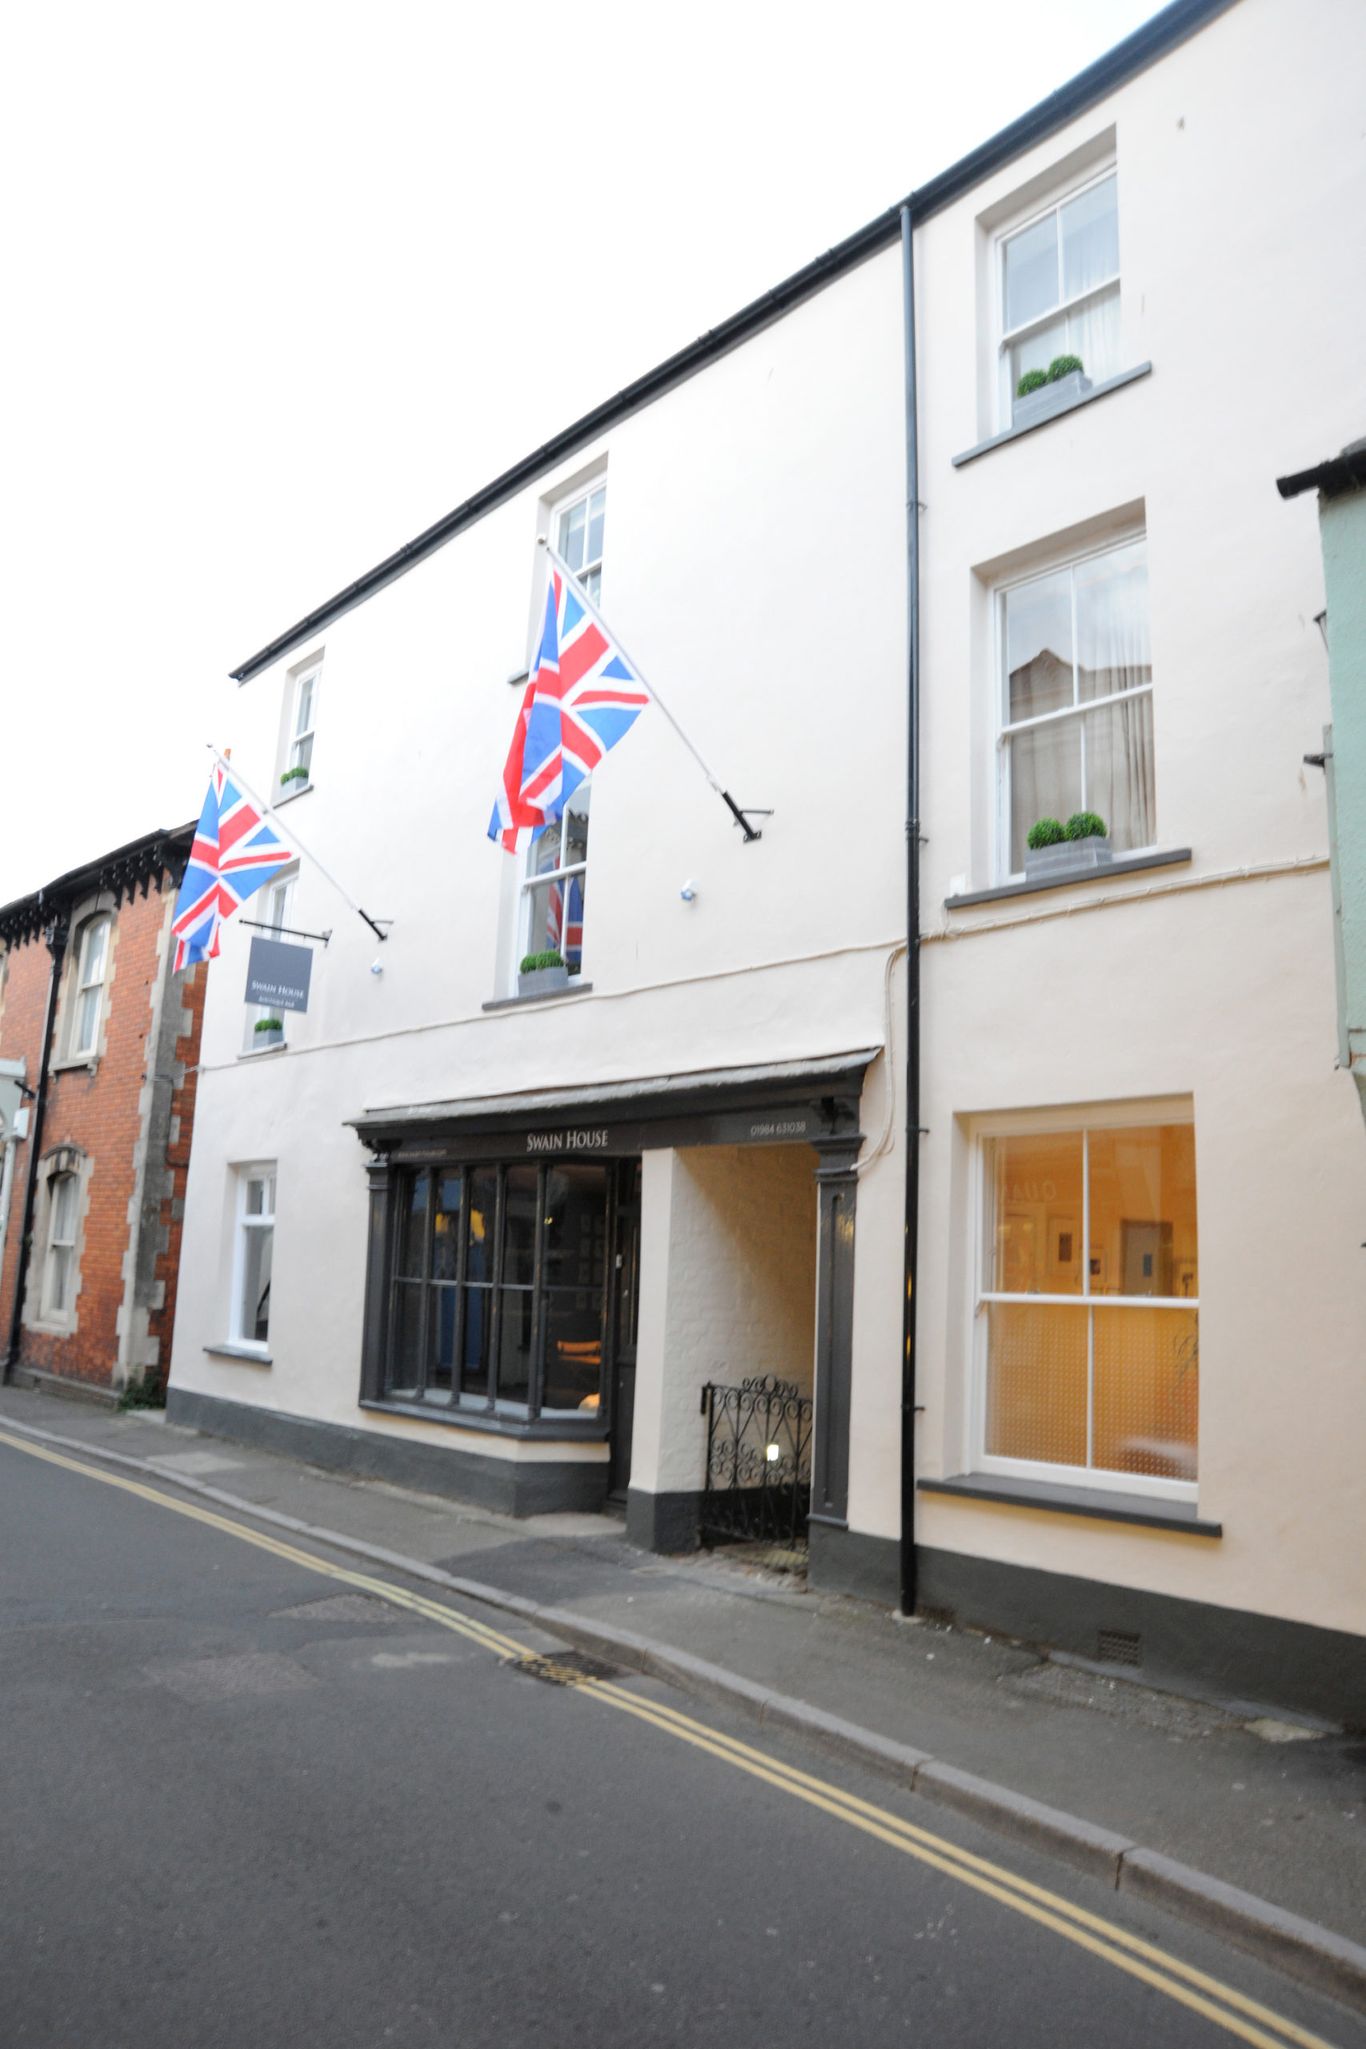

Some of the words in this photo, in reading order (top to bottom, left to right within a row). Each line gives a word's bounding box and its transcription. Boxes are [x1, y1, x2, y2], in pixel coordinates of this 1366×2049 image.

[750, 1123, 775, 1136] 01984
[526, 1132, 563, 1153] SWAIN
[566, 1129, 608, 1149] HOUSE
